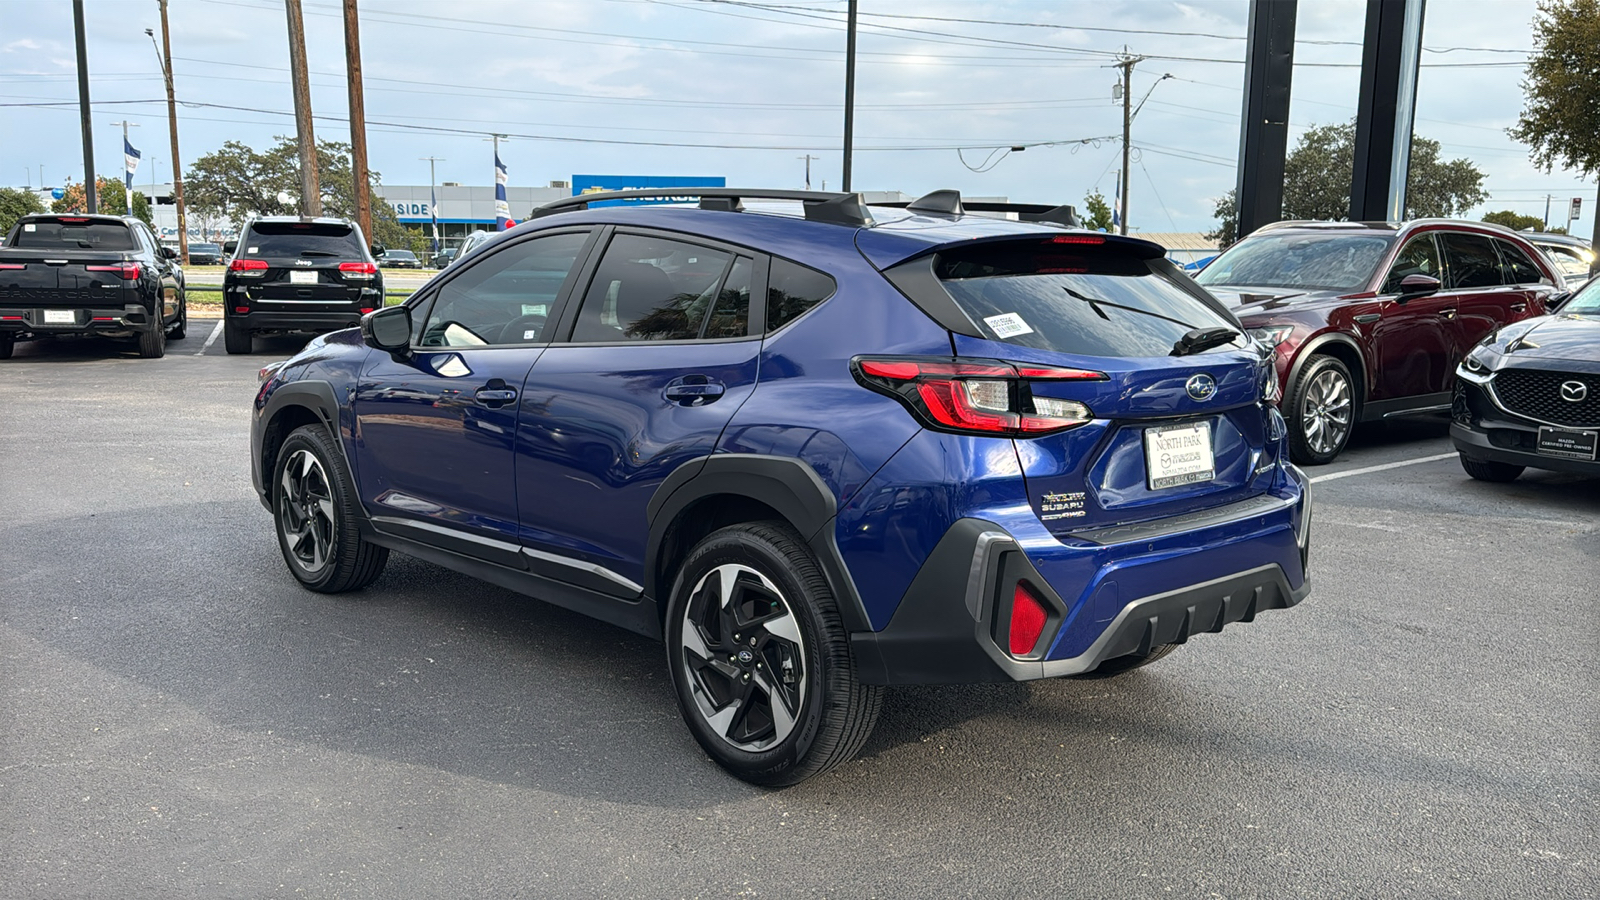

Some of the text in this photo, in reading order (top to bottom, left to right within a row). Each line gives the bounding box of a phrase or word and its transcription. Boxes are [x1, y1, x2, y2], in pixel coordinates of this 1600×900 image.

[1156, 434, 1202, 451] NORTH PARK
[1041, 501, 1084, 511] SUBARU
